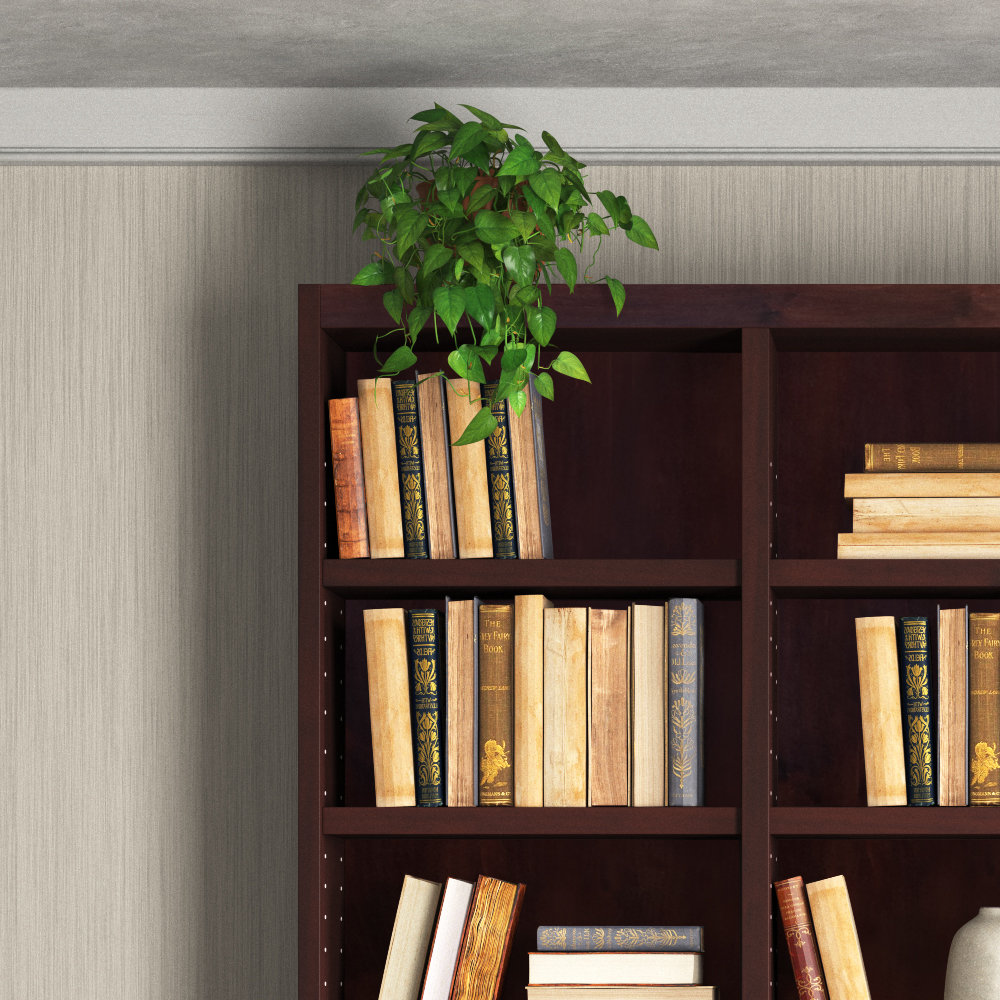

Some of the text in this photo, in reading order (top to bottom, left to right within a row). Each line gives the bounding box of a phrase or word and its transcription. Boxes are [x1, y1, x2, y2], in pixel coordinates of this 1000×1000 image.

[485, 619, 501, 628] THE
[975, 626, 992, 635] THE
[483, 644, 504, 653] BOOK
[974, 650, 994, 660] BOOK
